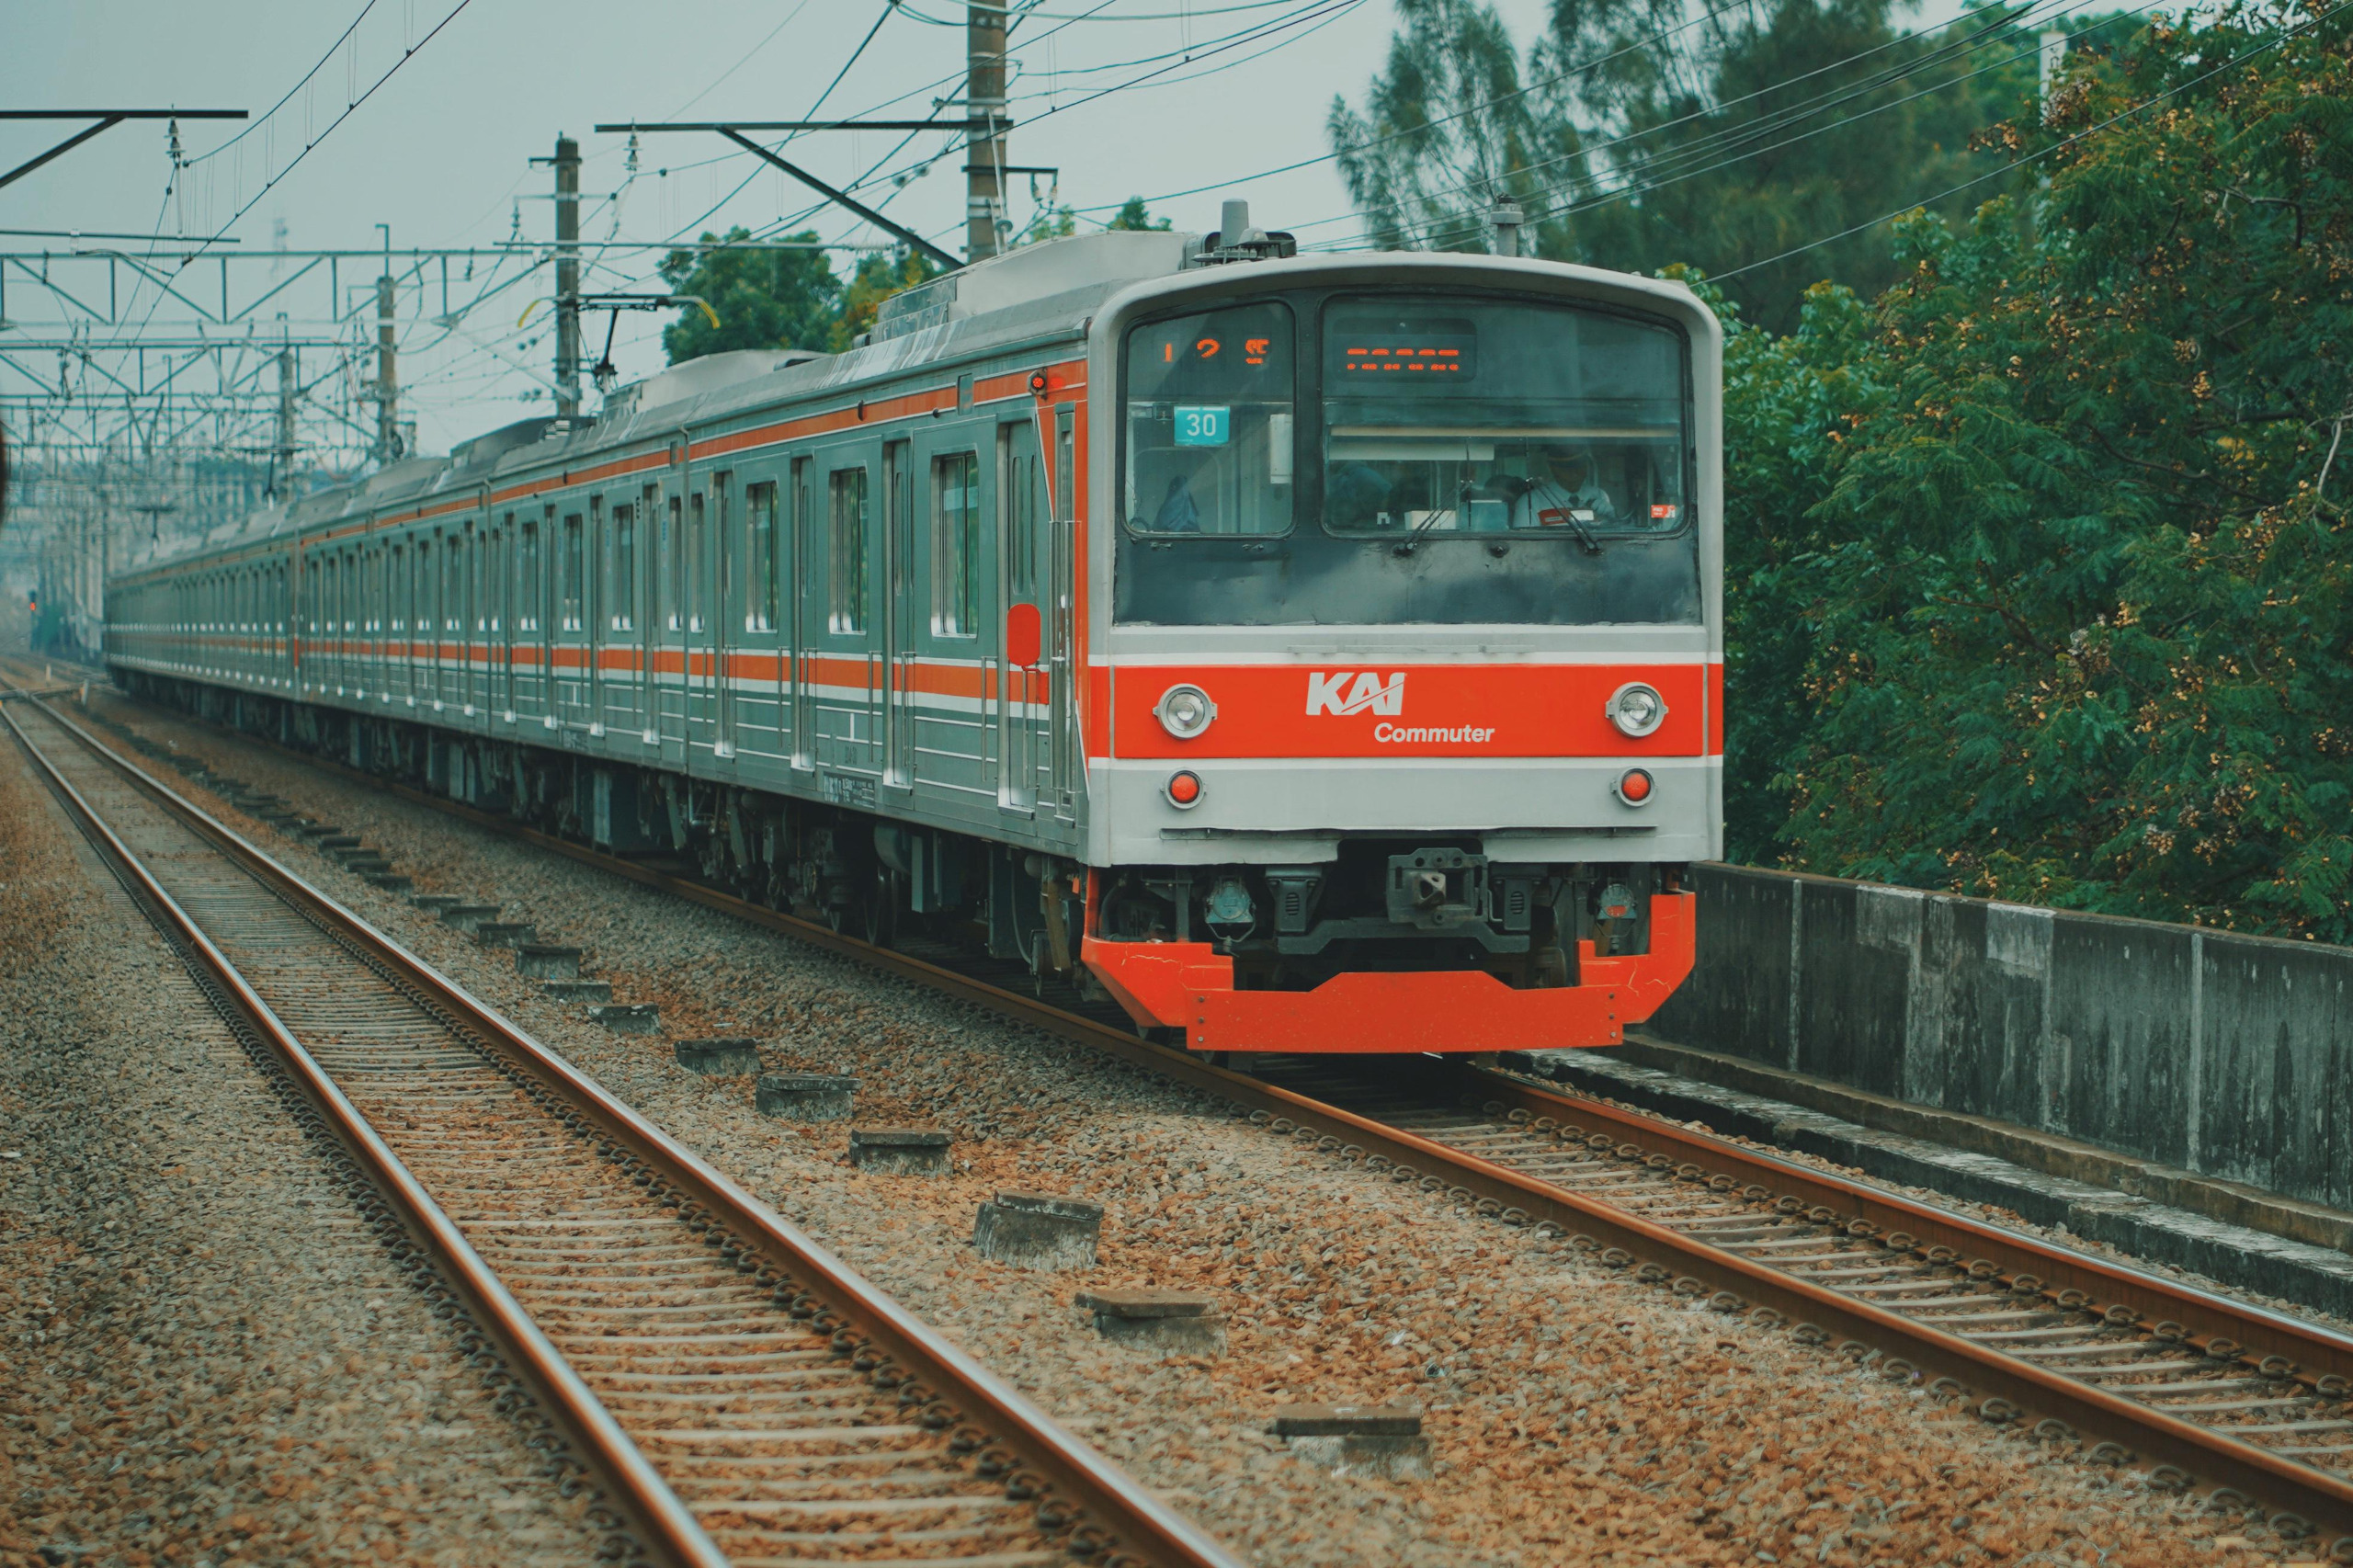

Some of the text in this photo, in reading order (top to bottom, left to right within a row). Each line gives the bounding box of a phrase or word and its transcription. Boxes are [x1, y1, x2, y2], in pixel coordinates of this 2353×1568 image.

[1187, 413, 1216, 437] 30
[1305, 672, 1406, 716] KAI
[1374, 722, 1495, 743] Commuter
